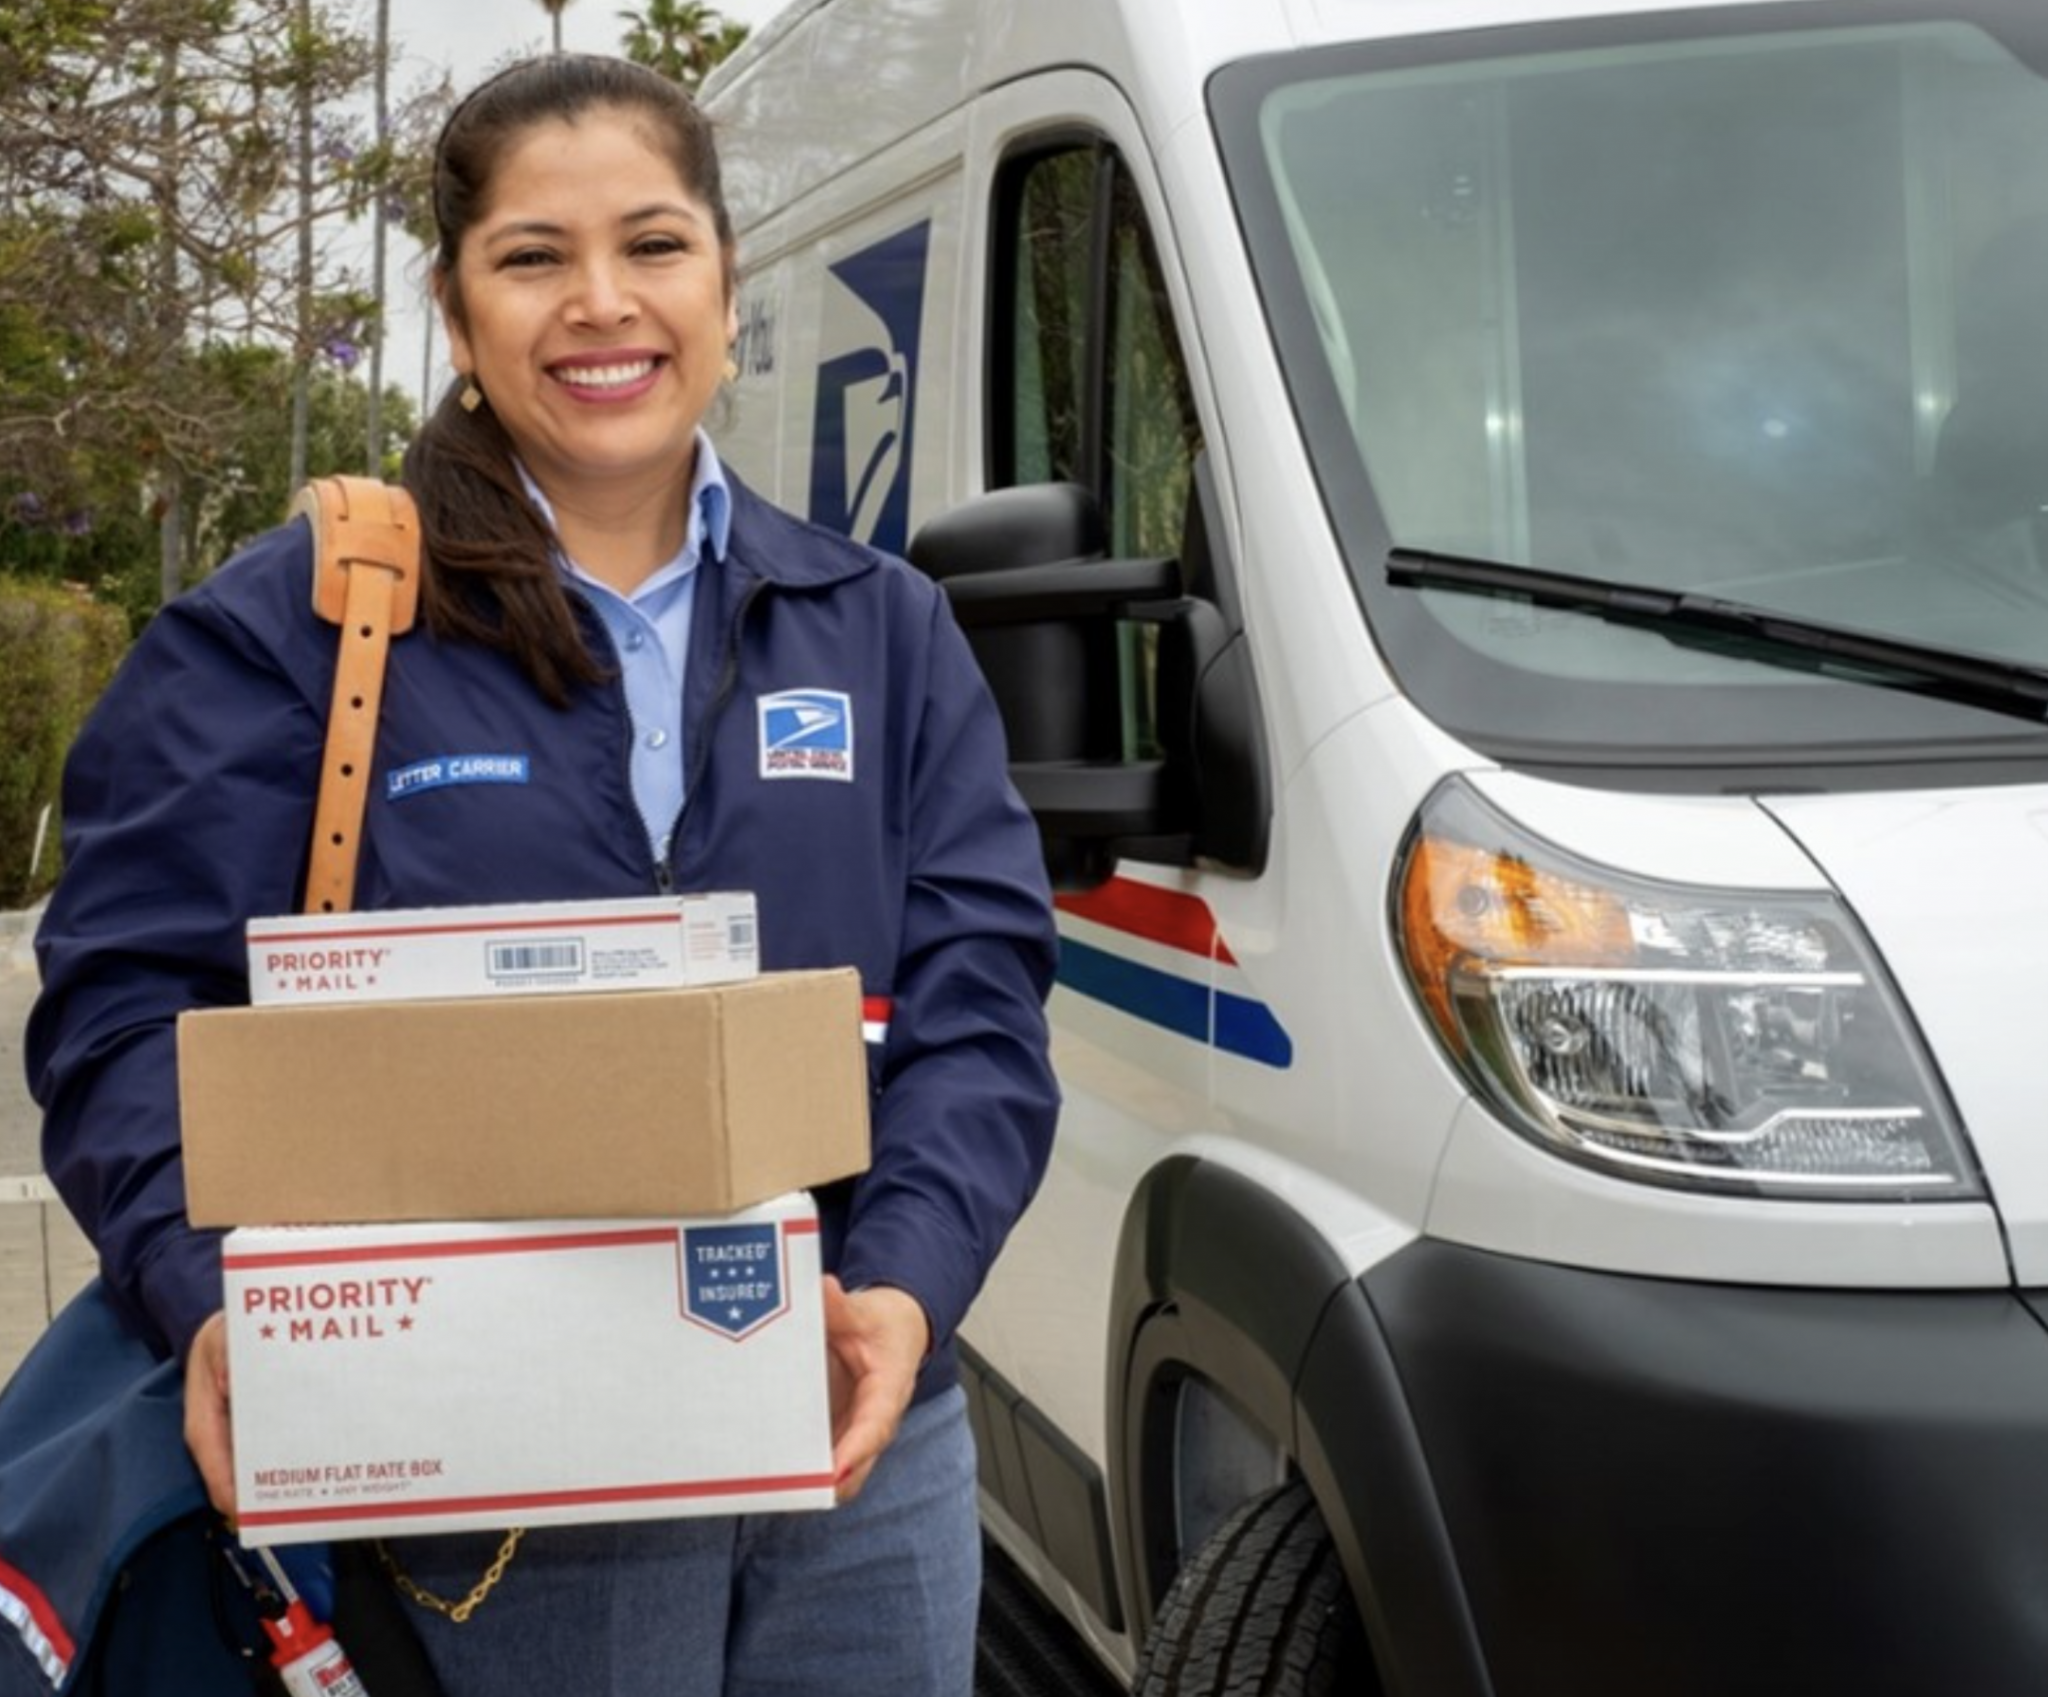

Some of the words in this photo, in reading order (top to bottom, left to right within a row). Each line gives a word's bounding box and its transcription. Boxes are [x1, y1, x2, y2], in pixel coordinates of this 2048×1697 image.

[449, 758, 523, 777] CARRIER
[296, 974, 358, 990] MAIL
[290, 1315, 384, 1342] MAIL
[254, 1466, 321, 1486] MEDIUM
[325, 1464, 363, 1482] FLAT
[367, 1461, 407, 1479] RATE
[410, 1459, 444, 1477] BOX
